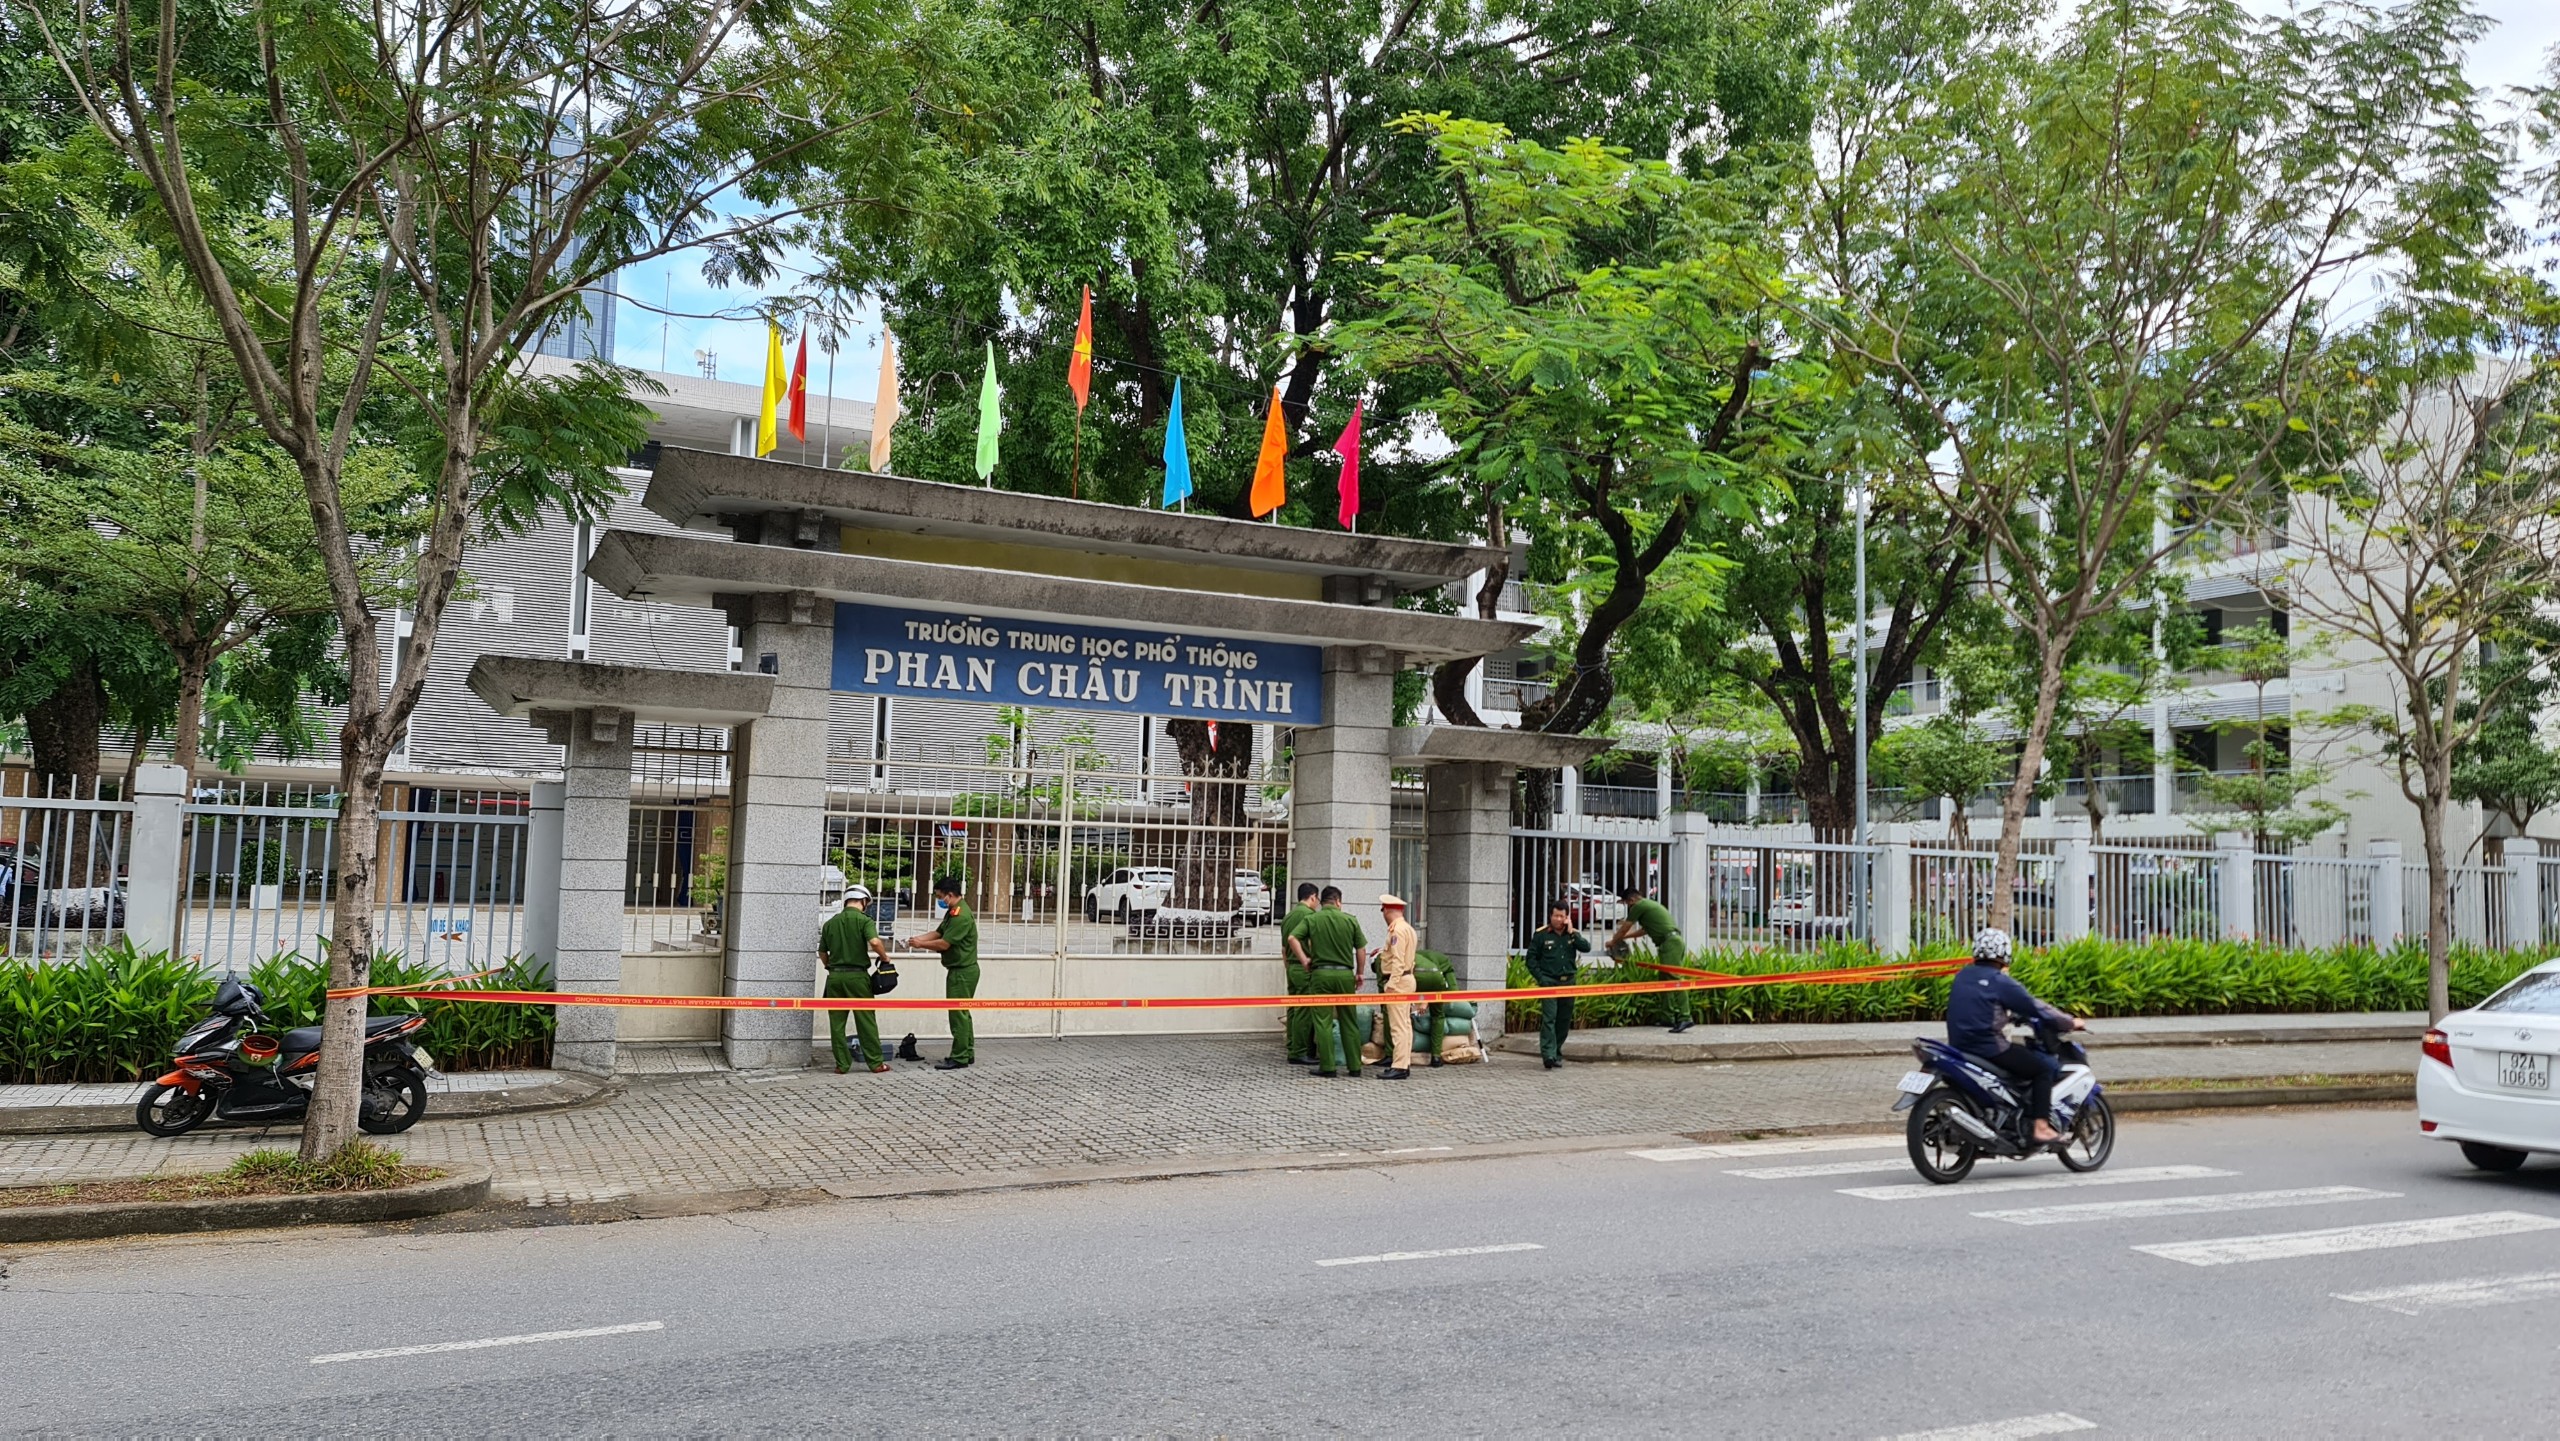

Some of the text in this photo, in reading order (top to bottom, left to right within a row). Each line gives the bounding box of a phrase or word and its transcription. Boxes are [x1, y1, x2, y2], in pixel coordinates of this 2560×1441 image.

[1007, 631, 1076, 654] TRUNG
[1082, 637, 1128, 662] HỌC
[1135, 635, 1182, 663] PHỔ
[1186, 642, 1258, 670] THÔNG
[863, 648, 996, 693] PHAN
[1017, 657, 1141, 703] CHÂU
[1347, 837, 1374, 856] 167
[2510, 1053, 2536, 1070] 92A
